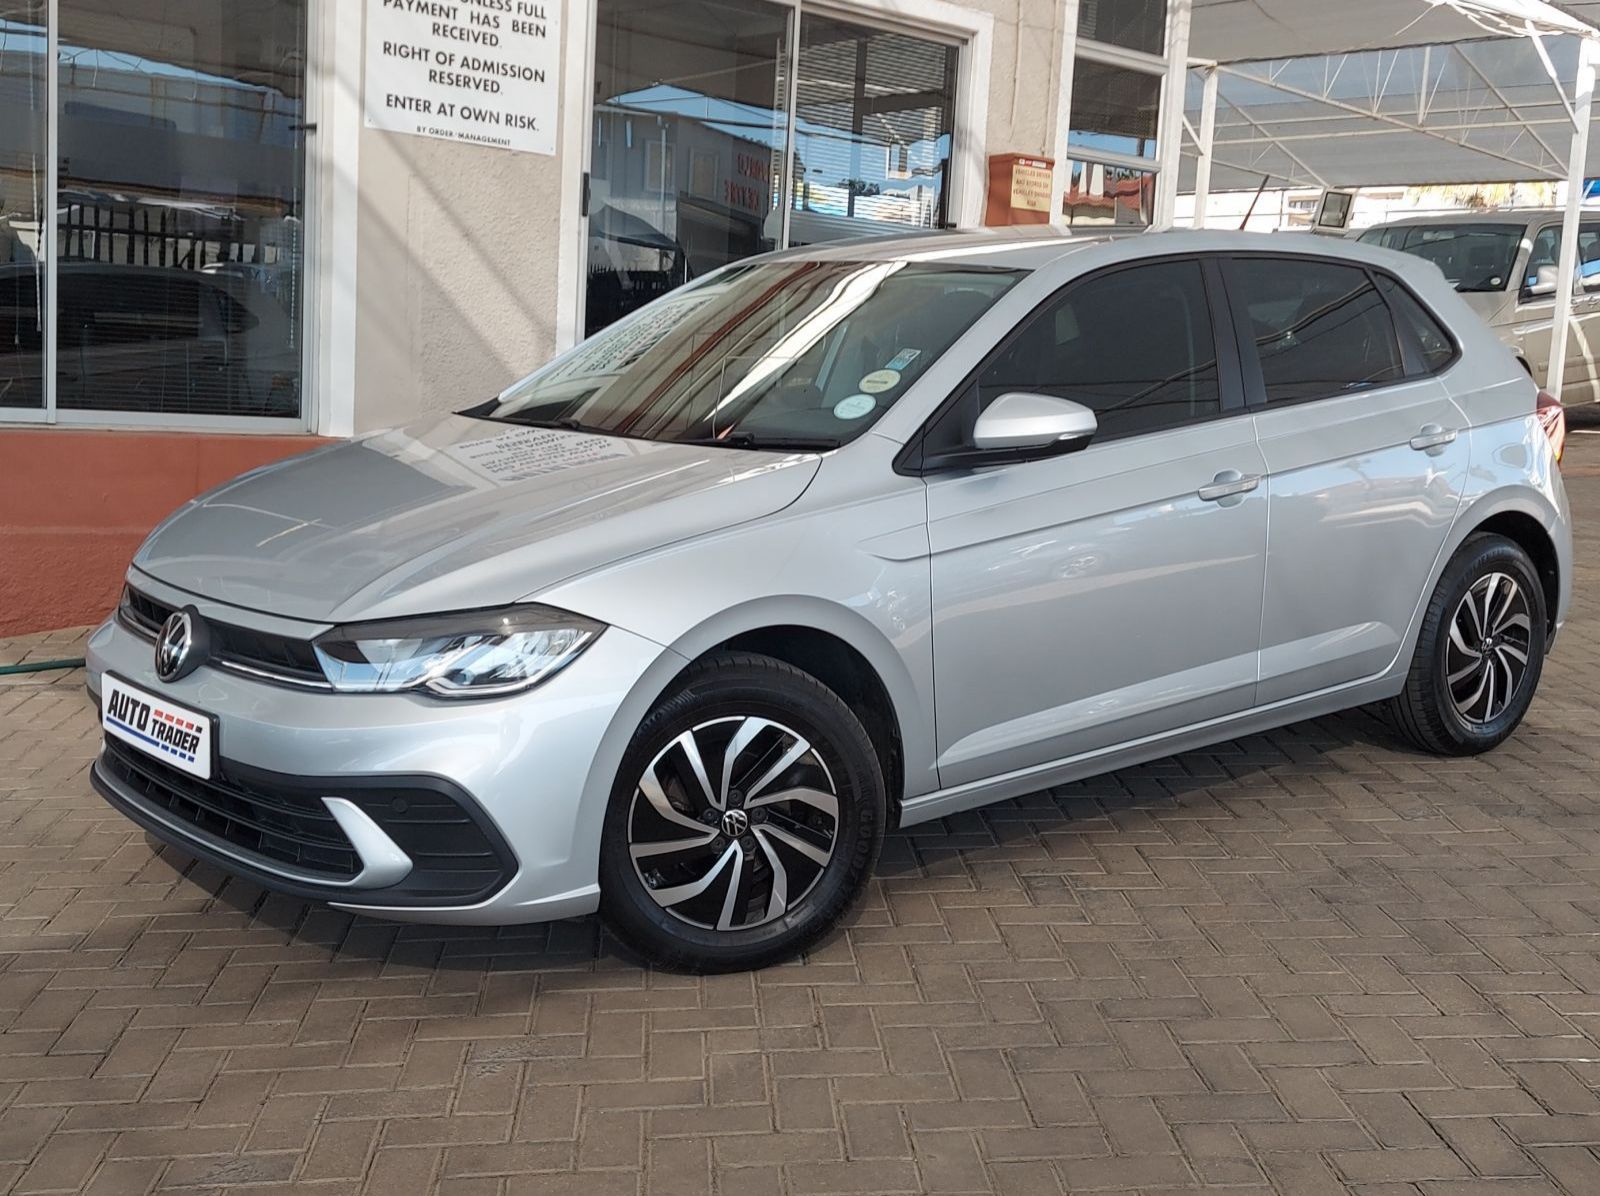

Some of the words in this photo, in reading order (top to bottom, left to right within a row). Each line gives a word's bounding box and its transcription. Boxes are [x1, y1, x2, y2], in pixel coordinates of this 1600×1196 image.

[383, 0, 458, 20] PAYMENT
[470, 10, 500, 29] HAS
[512, 19, 546, 38] BEEN
[461, 0, 512, 12] LESS
[517, 2, 547, 19] FULL
[432, 22, 502, 48] RECEIVED.
[383, 41, 430, 62] RIGHT
[435, 51, 456, 66] OF
[460, 56, 545, 83] ADMISSION
[429, 69, 503, 95] RESERVED.
[386, 93, 432, 114] ENTER
[437, 102, 456, 117] AT
[460, 106, 500, 125] OWN
[505, 113, 540, 132] RISK.
[416, 125, 427, 133] BY
[428, 127, 454, 137] ORDER
[457, 132, 511, 146] MANAGEMENT
[107, 689, 151, 732] AUTO
[150, 718, 200, 755] TRADER
